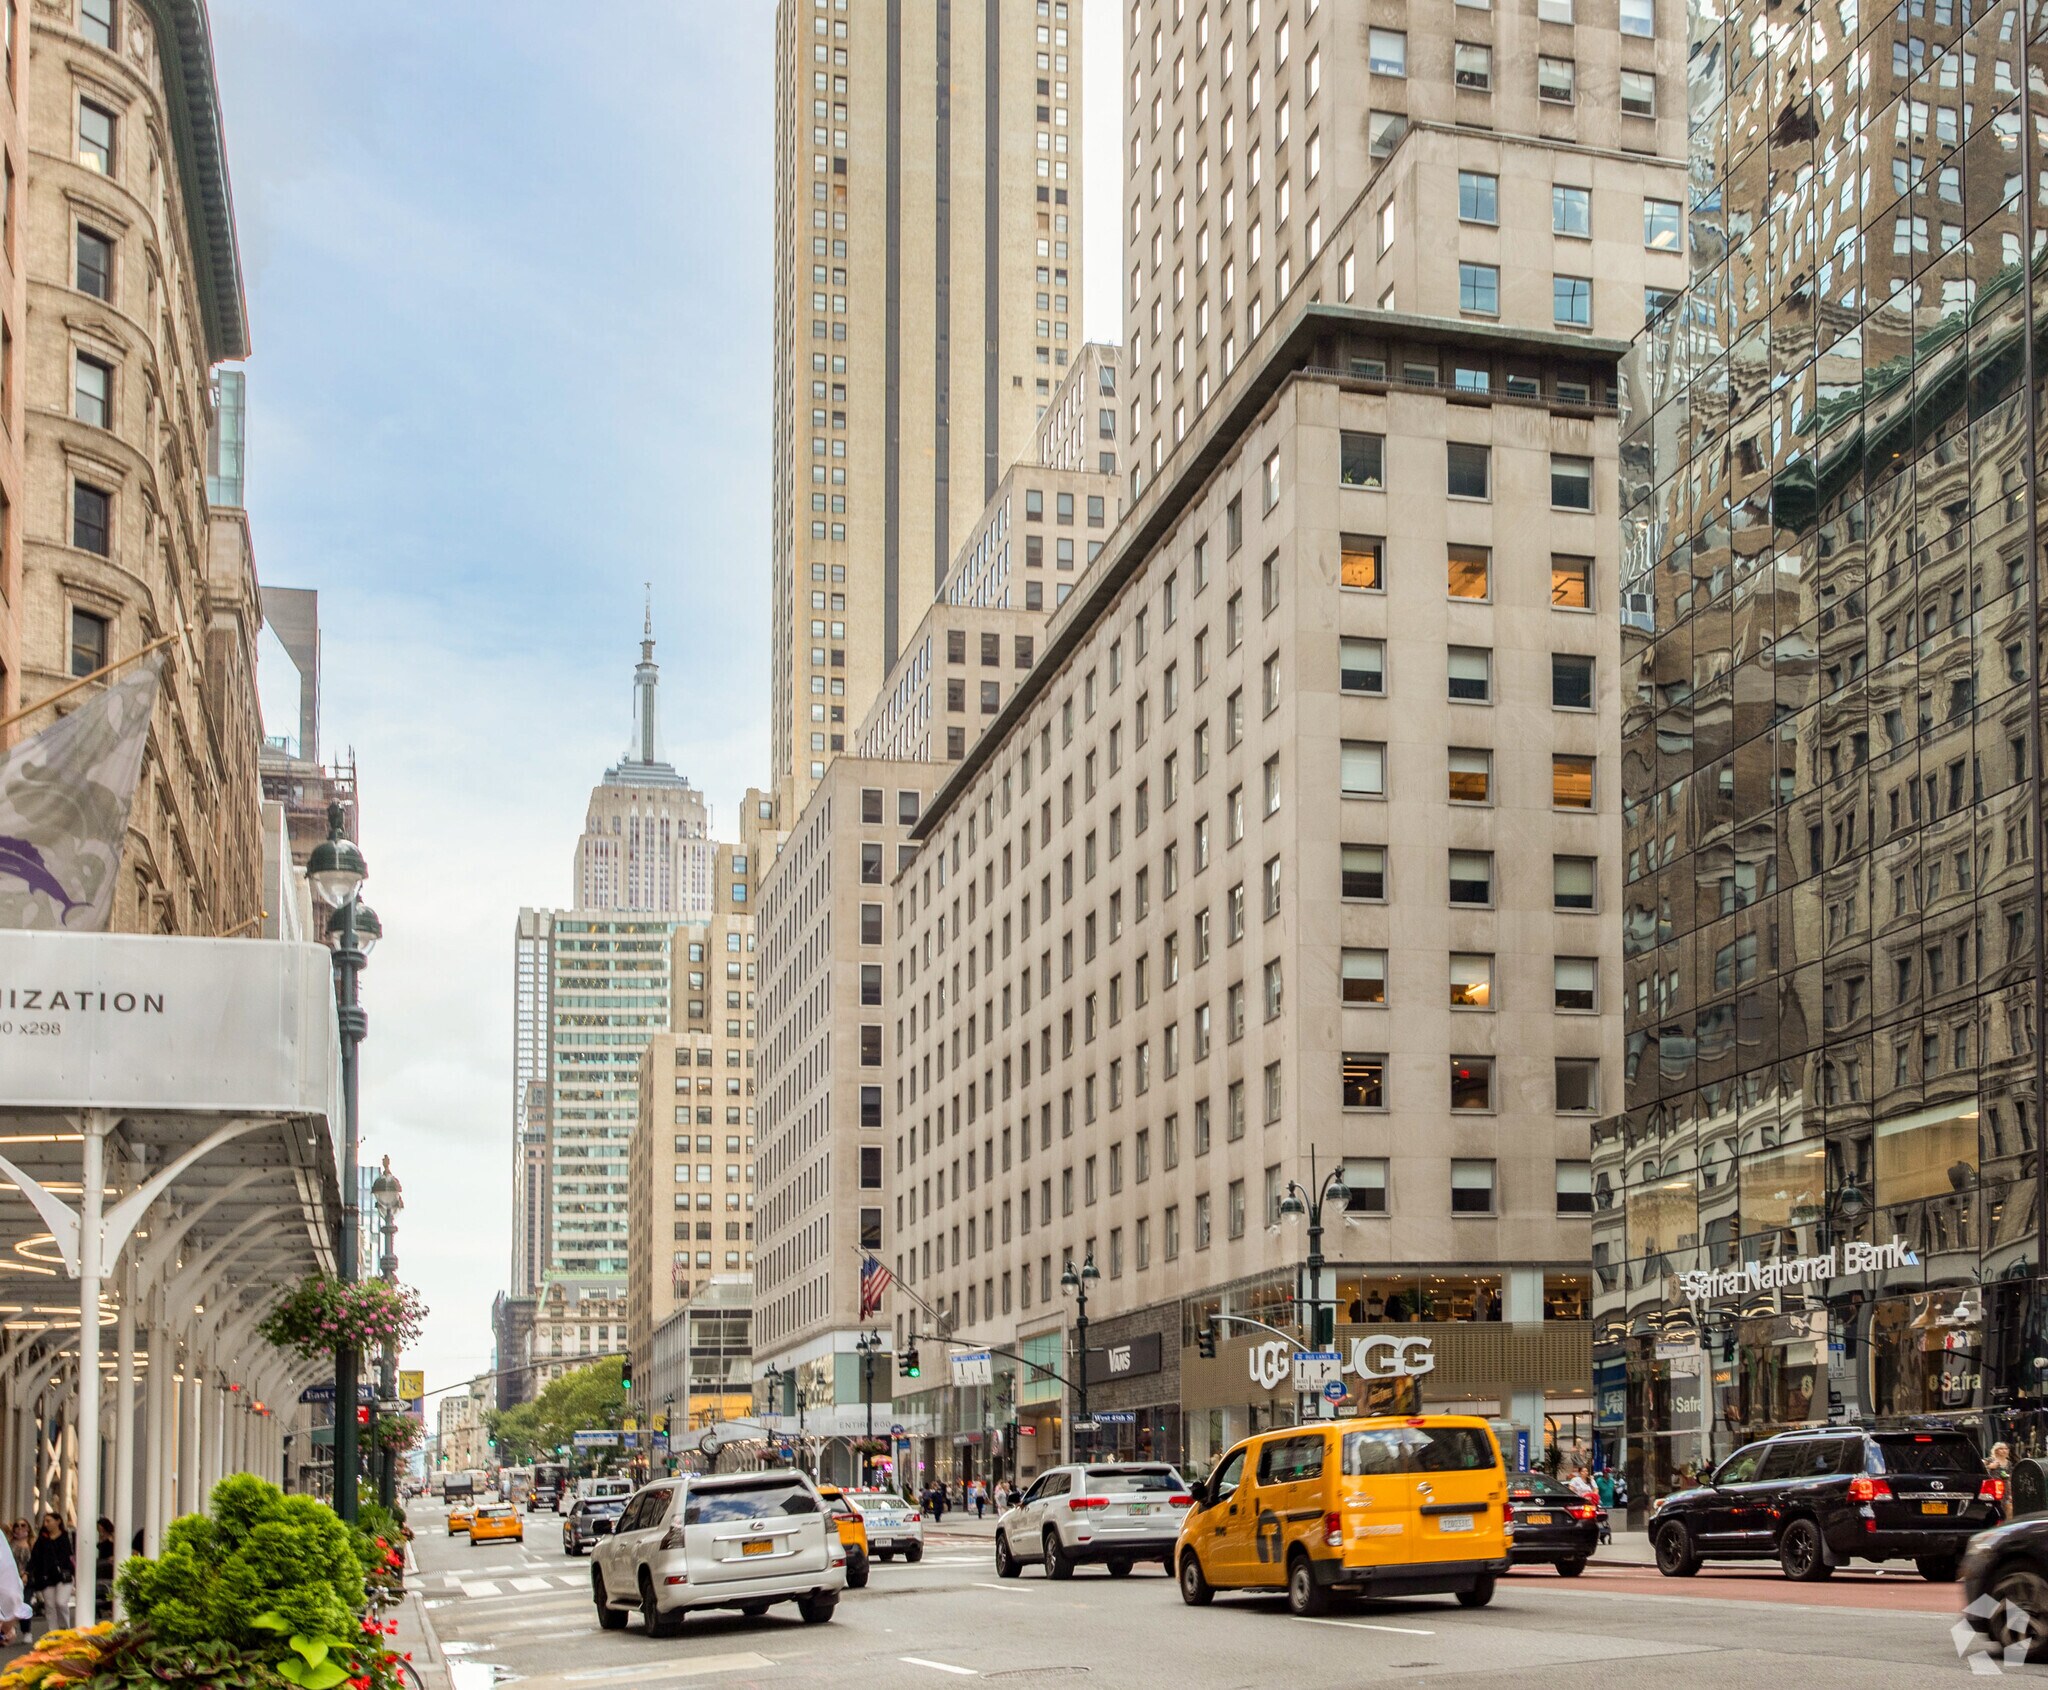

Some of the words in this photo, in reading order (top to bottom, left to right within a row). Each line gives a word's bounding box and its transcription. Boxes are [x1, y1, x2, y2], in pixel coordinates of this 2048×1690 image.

[0, 989, 164, 1013] IZATION
[18, 1021, 61, 1036] x298
[1685, 1268, 1739, 1301] Safra
[1745, 1246, 1836, 1293] National
[1844, 1234, 1909, 1275] Bank
[1249, 1341, 1290, 1390] UGG
[1941, 1371, 1982, 1391] Safra
[306, 1389, 330, 1400] East
[840, 1421, 867, 1430] ENTIR
[1094, 1413, 1111, 1421] West
[1127, 1413, 1135, 1421] St
